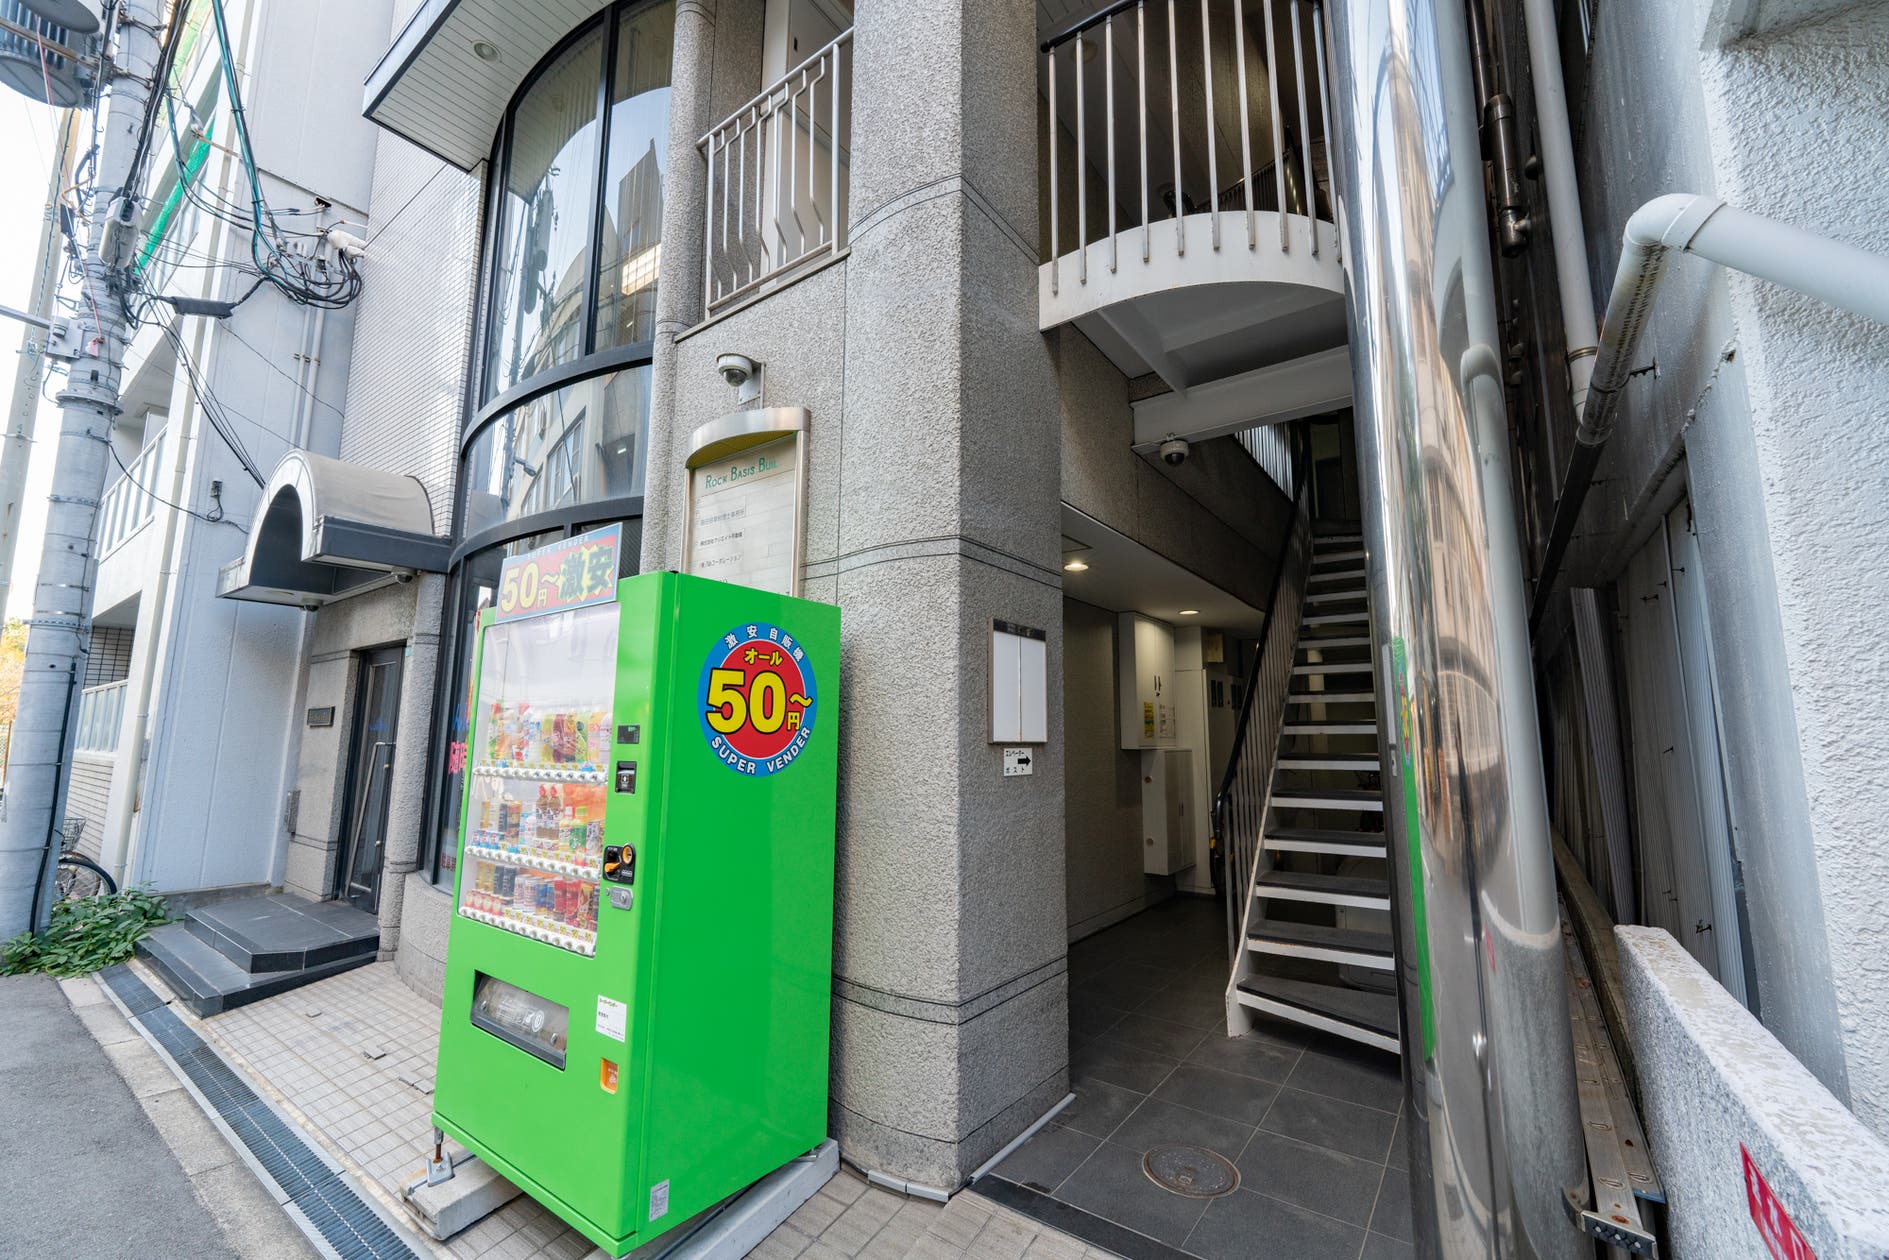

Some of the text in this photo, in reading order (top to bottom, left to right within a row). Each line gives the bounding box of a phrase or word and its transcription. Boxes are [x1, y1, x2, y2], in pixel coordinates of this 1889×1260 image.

[743, 647, 783, 667] オール
[711, 726, 811, 775] SUPER VENDER
